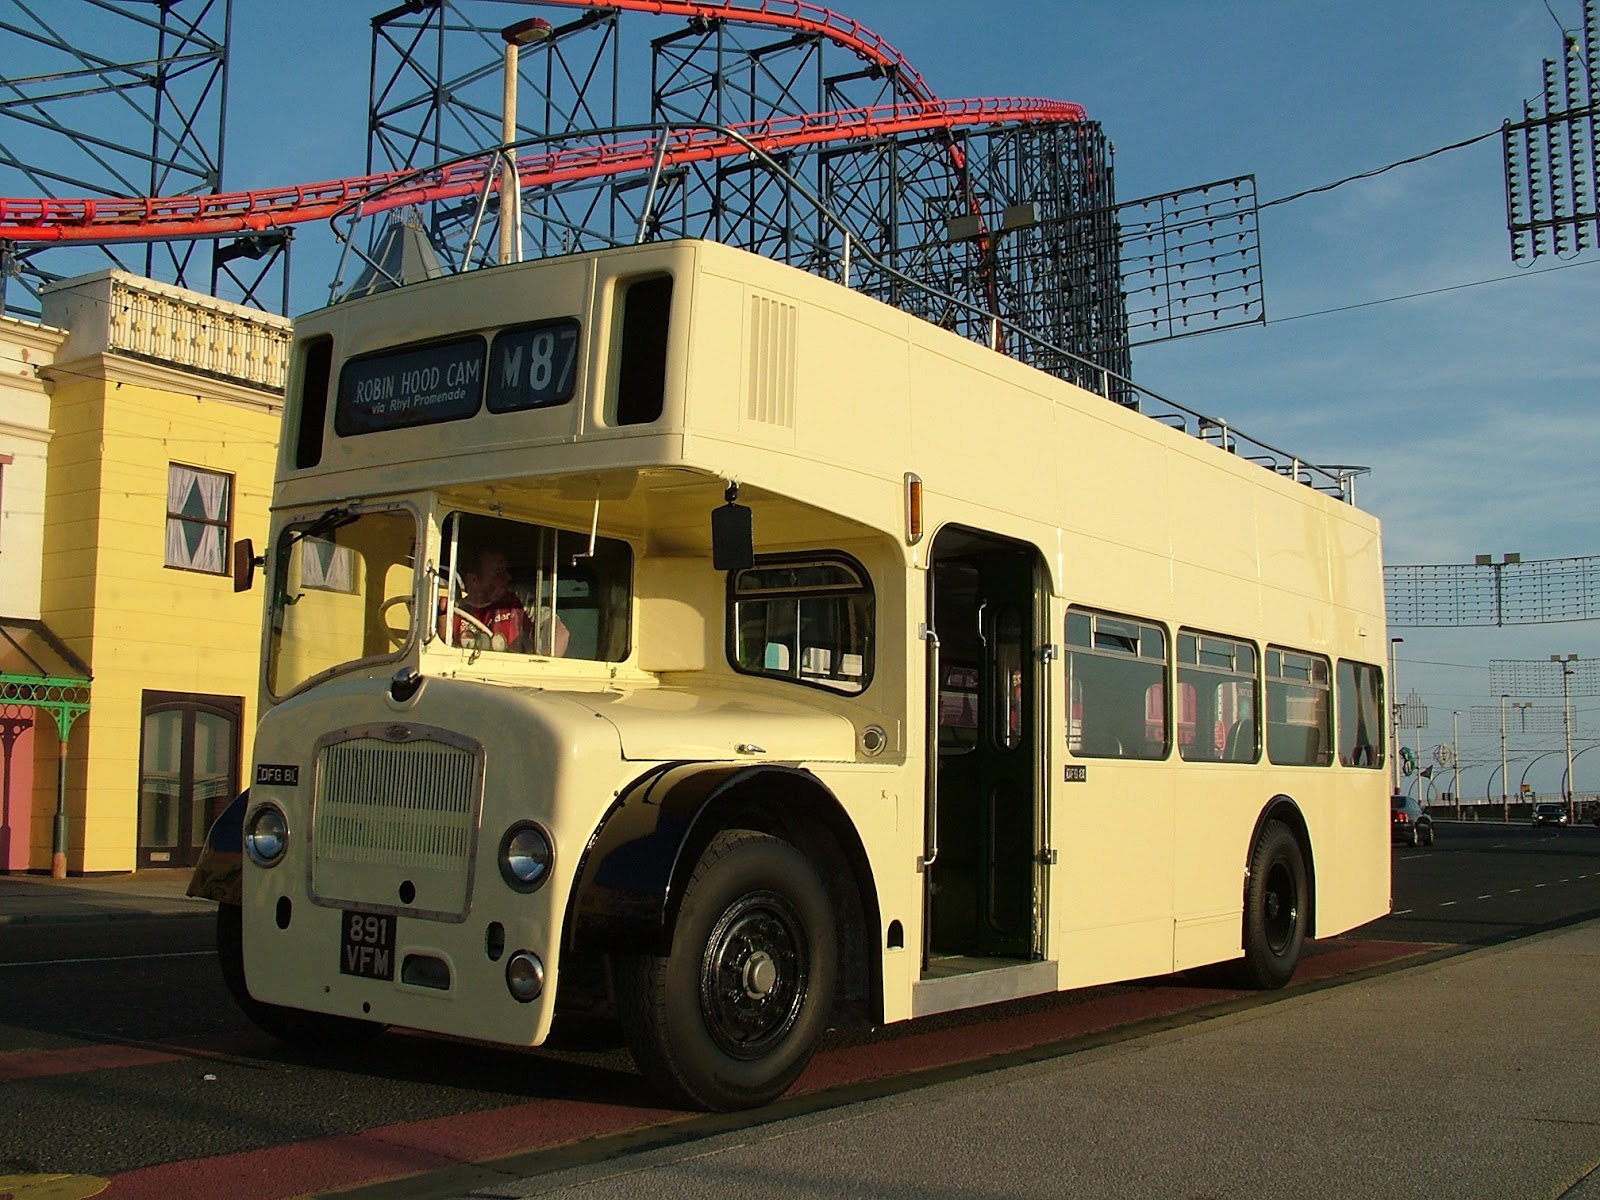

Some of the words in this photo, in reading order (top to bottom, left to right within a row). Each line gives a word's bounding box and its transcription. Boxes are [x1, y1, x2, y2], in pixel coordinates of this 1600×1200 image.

[355, 376, 395, 404] ROBIN
[401, 366, 440, 395] HOOD
[371, 403, 385, 415] via
[390, 396, 411, 412] Rhyl
[414, 387, 466, 407] Promenade
[261, 768, 282, 781] DFG
[349, 914, 388, 946] 891
[346, 944, 390, 976] VFM
